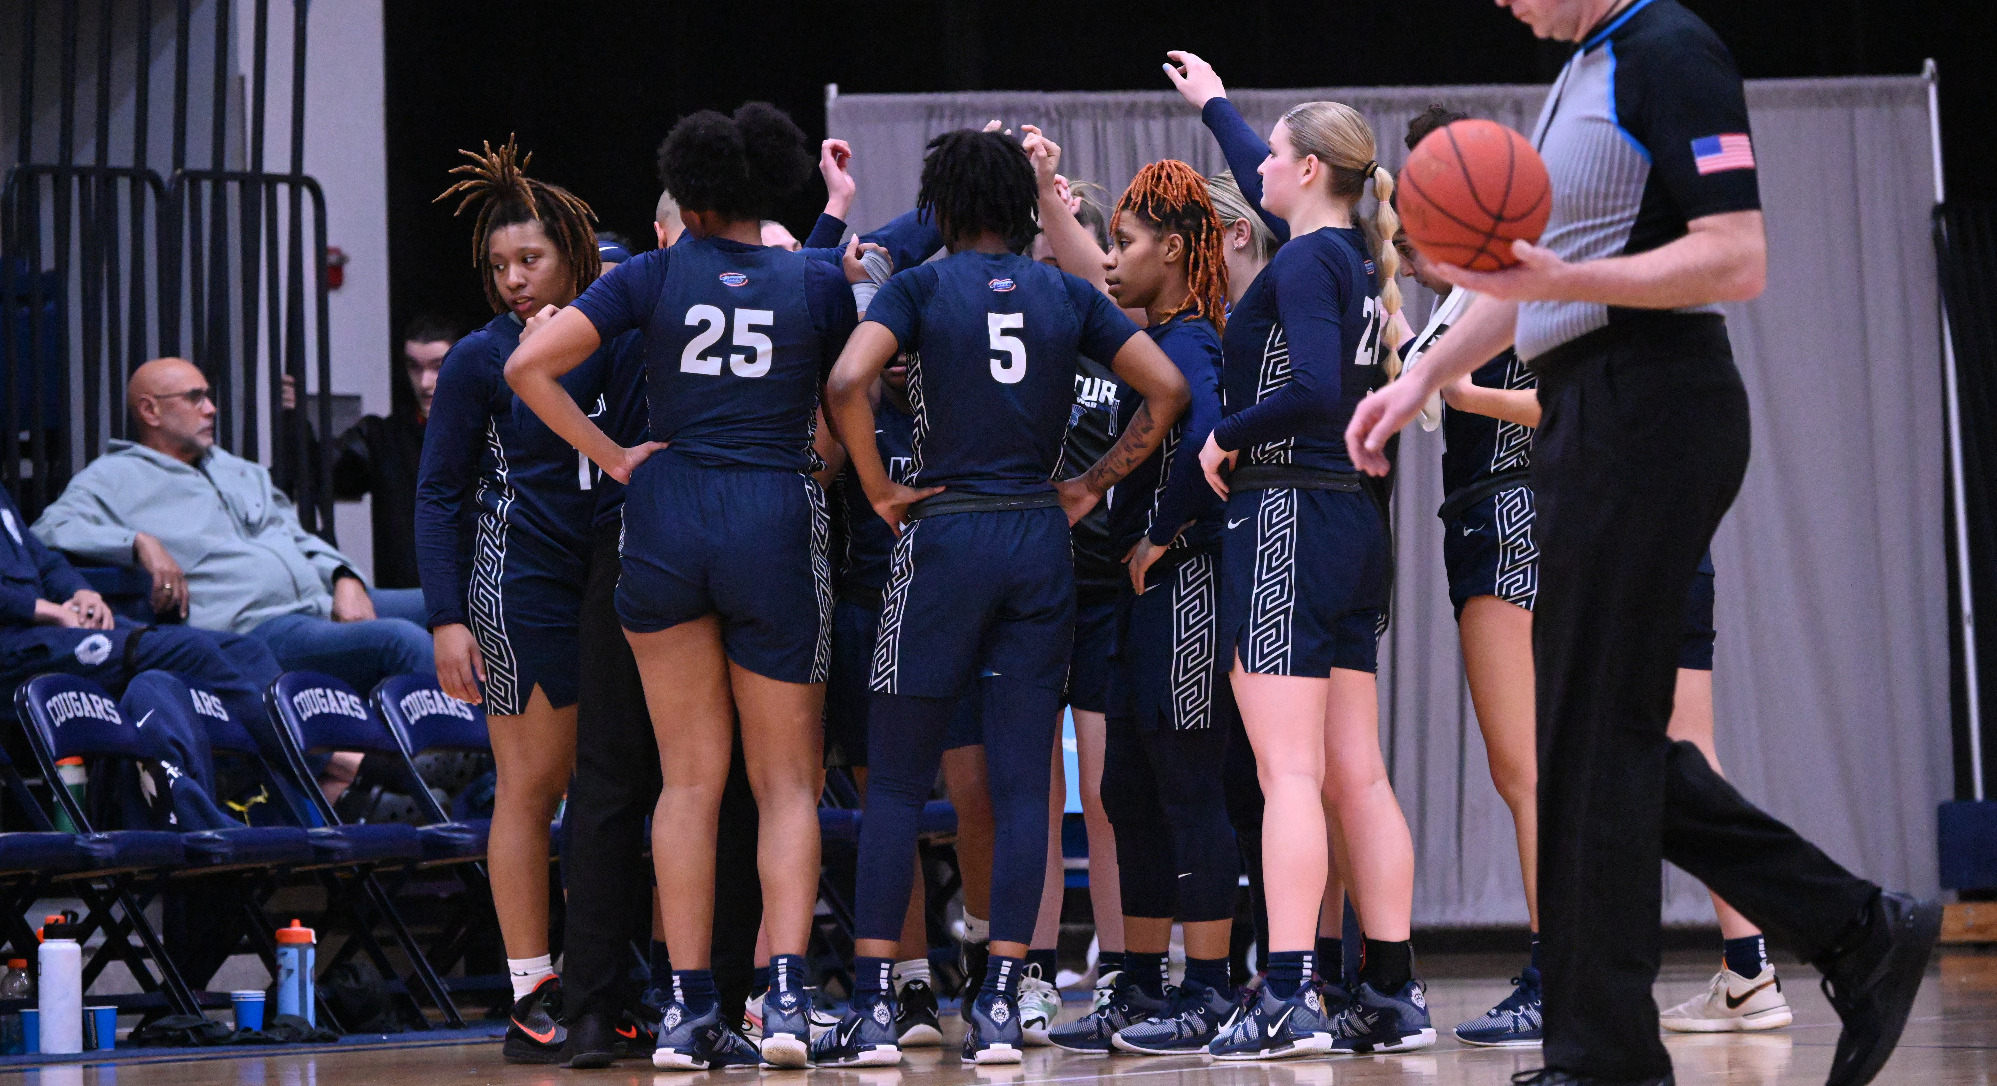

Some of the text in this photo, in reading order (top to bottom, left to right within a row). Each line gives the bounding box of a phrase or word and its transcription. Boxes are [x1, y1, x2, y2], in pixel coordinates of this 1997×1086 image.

[680, 304, 774, 378] 25
[987, 312, 1027, 384] 5
[45, 691, 123, 727] COUGARS
[293, 687, 367, 722] COUGARS
[400, 689, 475, 726] COUGARS
